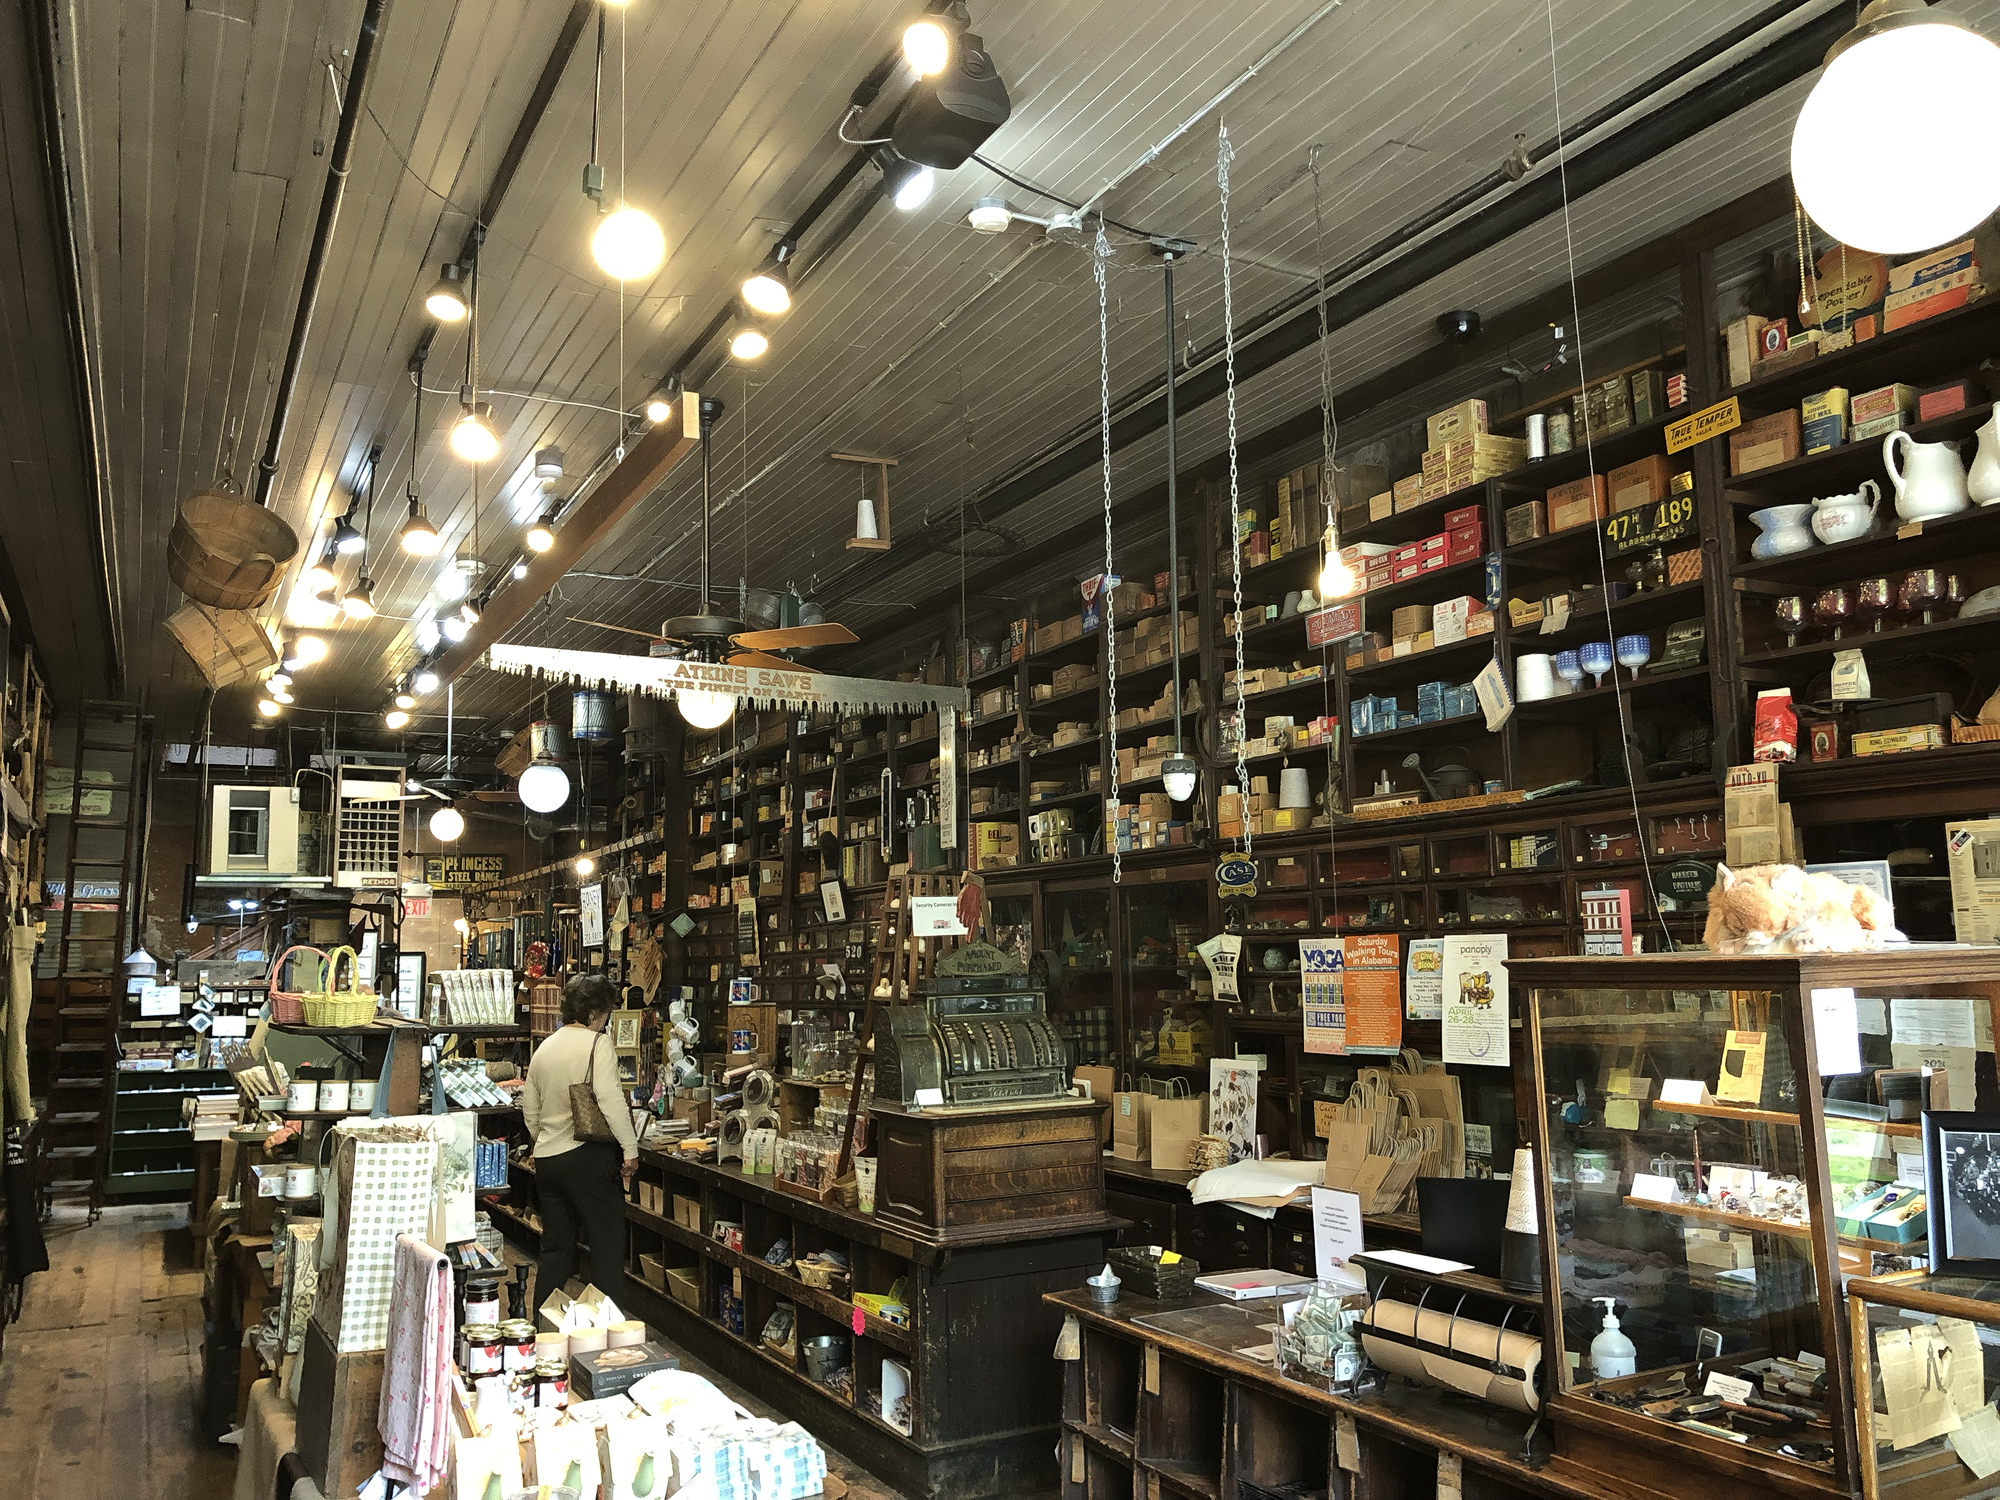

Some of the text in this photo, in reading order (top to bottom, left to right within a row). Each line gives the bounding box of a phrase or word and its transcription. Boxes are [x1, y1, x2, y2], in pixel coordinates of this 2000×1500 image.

[1807, 404, 1827, 414] LIQUID
[1670, 403, 1733, 441] TRUE TEMPER
[1607, 513, 1629, 541] 47
[1657, 497, 1693, 528] 189
[1618, 533, 1657, 550] ALABAMA
[674, 663, 812, 690] ATKINS SAWS
[699, 682, 750, 695] FINEST
[1869, 735, 1908, 746] KING EDWARD
[362, 879, 396, 887] REZNOR
[448, 872, 500, 883] STEEL RANGE
[81, 885, 120, 897] Grass
[405, 898, 427, 915] EXIT
[1357, 938, 1388, 947] Saturday
[845, 945, 862, 959] 520
[965, 950, 995, 961] AMOUNT
[1346, 946, 1399, 959] Walking Tours
[1460, 945, 1492, 955] panoply
[1352, 956, 1392, 965] in Alabama
[1417, 961, 1435, 969] Blood
[957, 961, 1002, 972] PURCHASED
[1316, 1012, 1331, 1022] FREE
[1448, 1007, 1474, 1017] APRIL
[1448, 1016, 1474, 1024] 26-28
